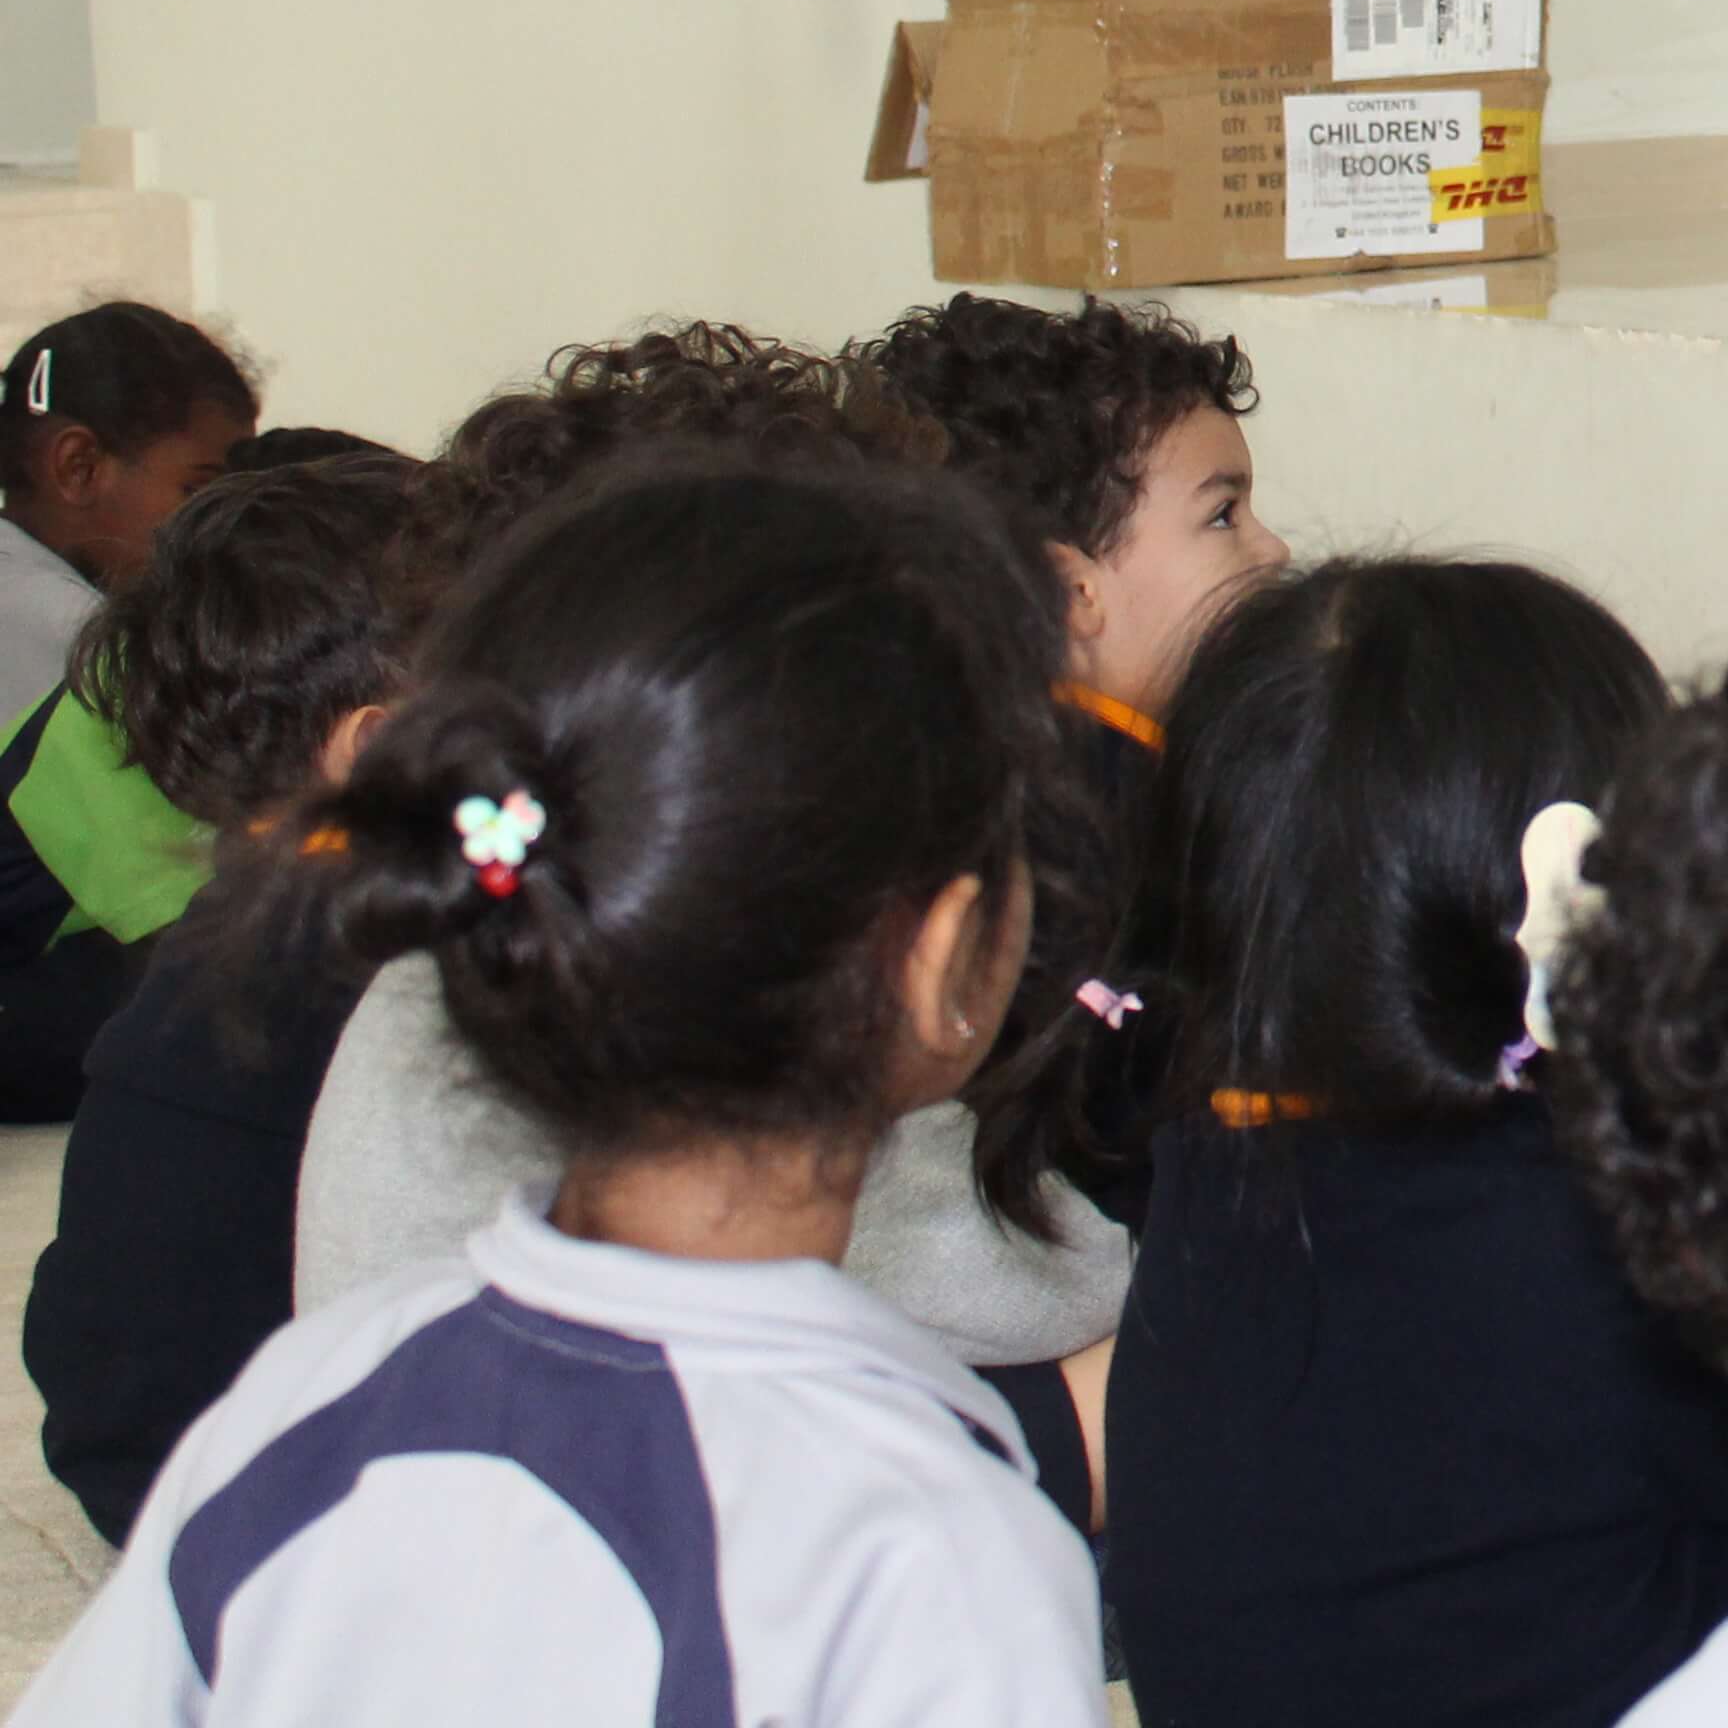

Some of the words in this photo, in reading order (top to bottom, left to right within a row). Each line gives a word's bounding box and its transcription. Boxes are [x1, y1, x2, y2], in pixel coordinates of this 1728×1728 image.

[1347, 98, 1417, 113] CONTENTS
[1309, 119, 1461, 146] CHILDREN'S
[1341, 153, 1432, 178] BOOKS
[1440, 175, 1528, 211] DHL
